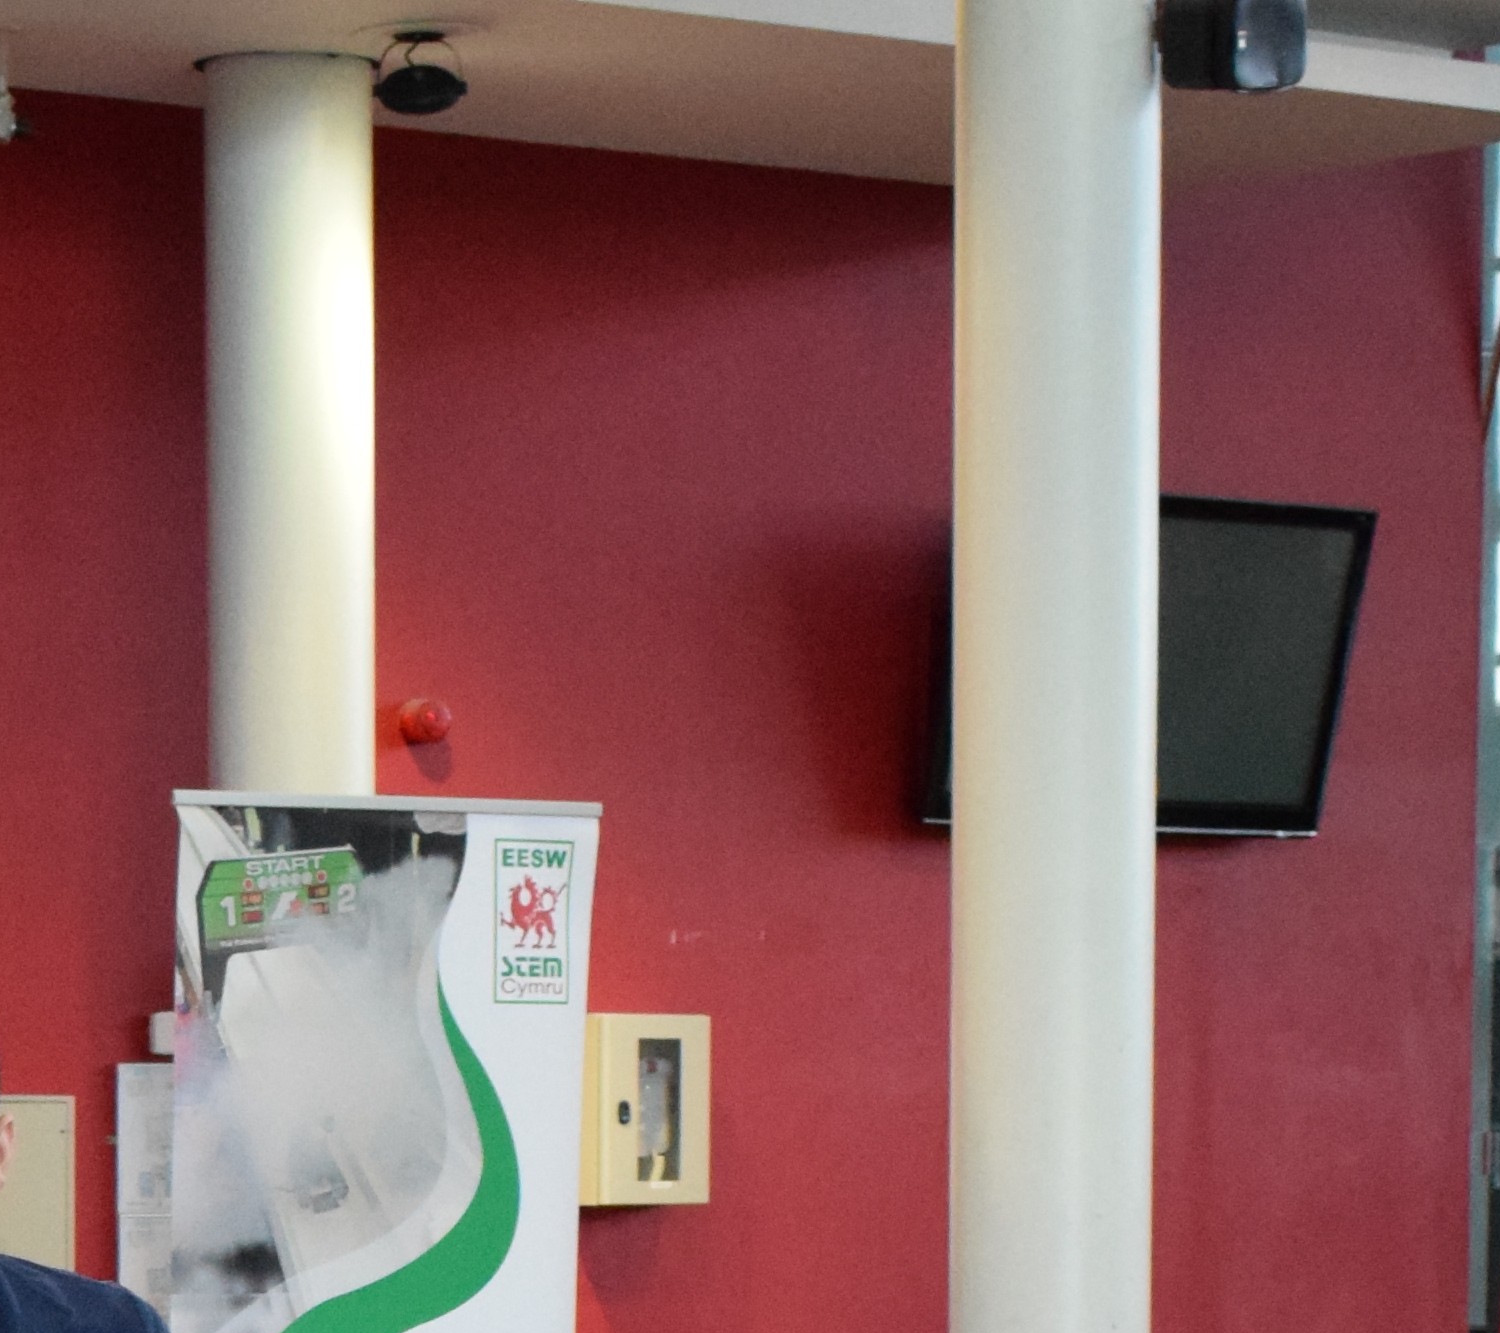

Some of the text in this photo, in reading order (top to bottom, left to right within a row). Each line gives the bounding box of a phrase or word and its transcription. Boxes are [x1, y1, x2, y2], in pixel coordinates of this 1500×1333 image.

[245, 855, 326, 876] START
[502, 848, 567, 868] EESW
[337, 883, 356, 913] 2
[220, 896, 237, 927] 1
[501, 956, 563, 977] STEM
[501, 978, 564, 997] Cymru
